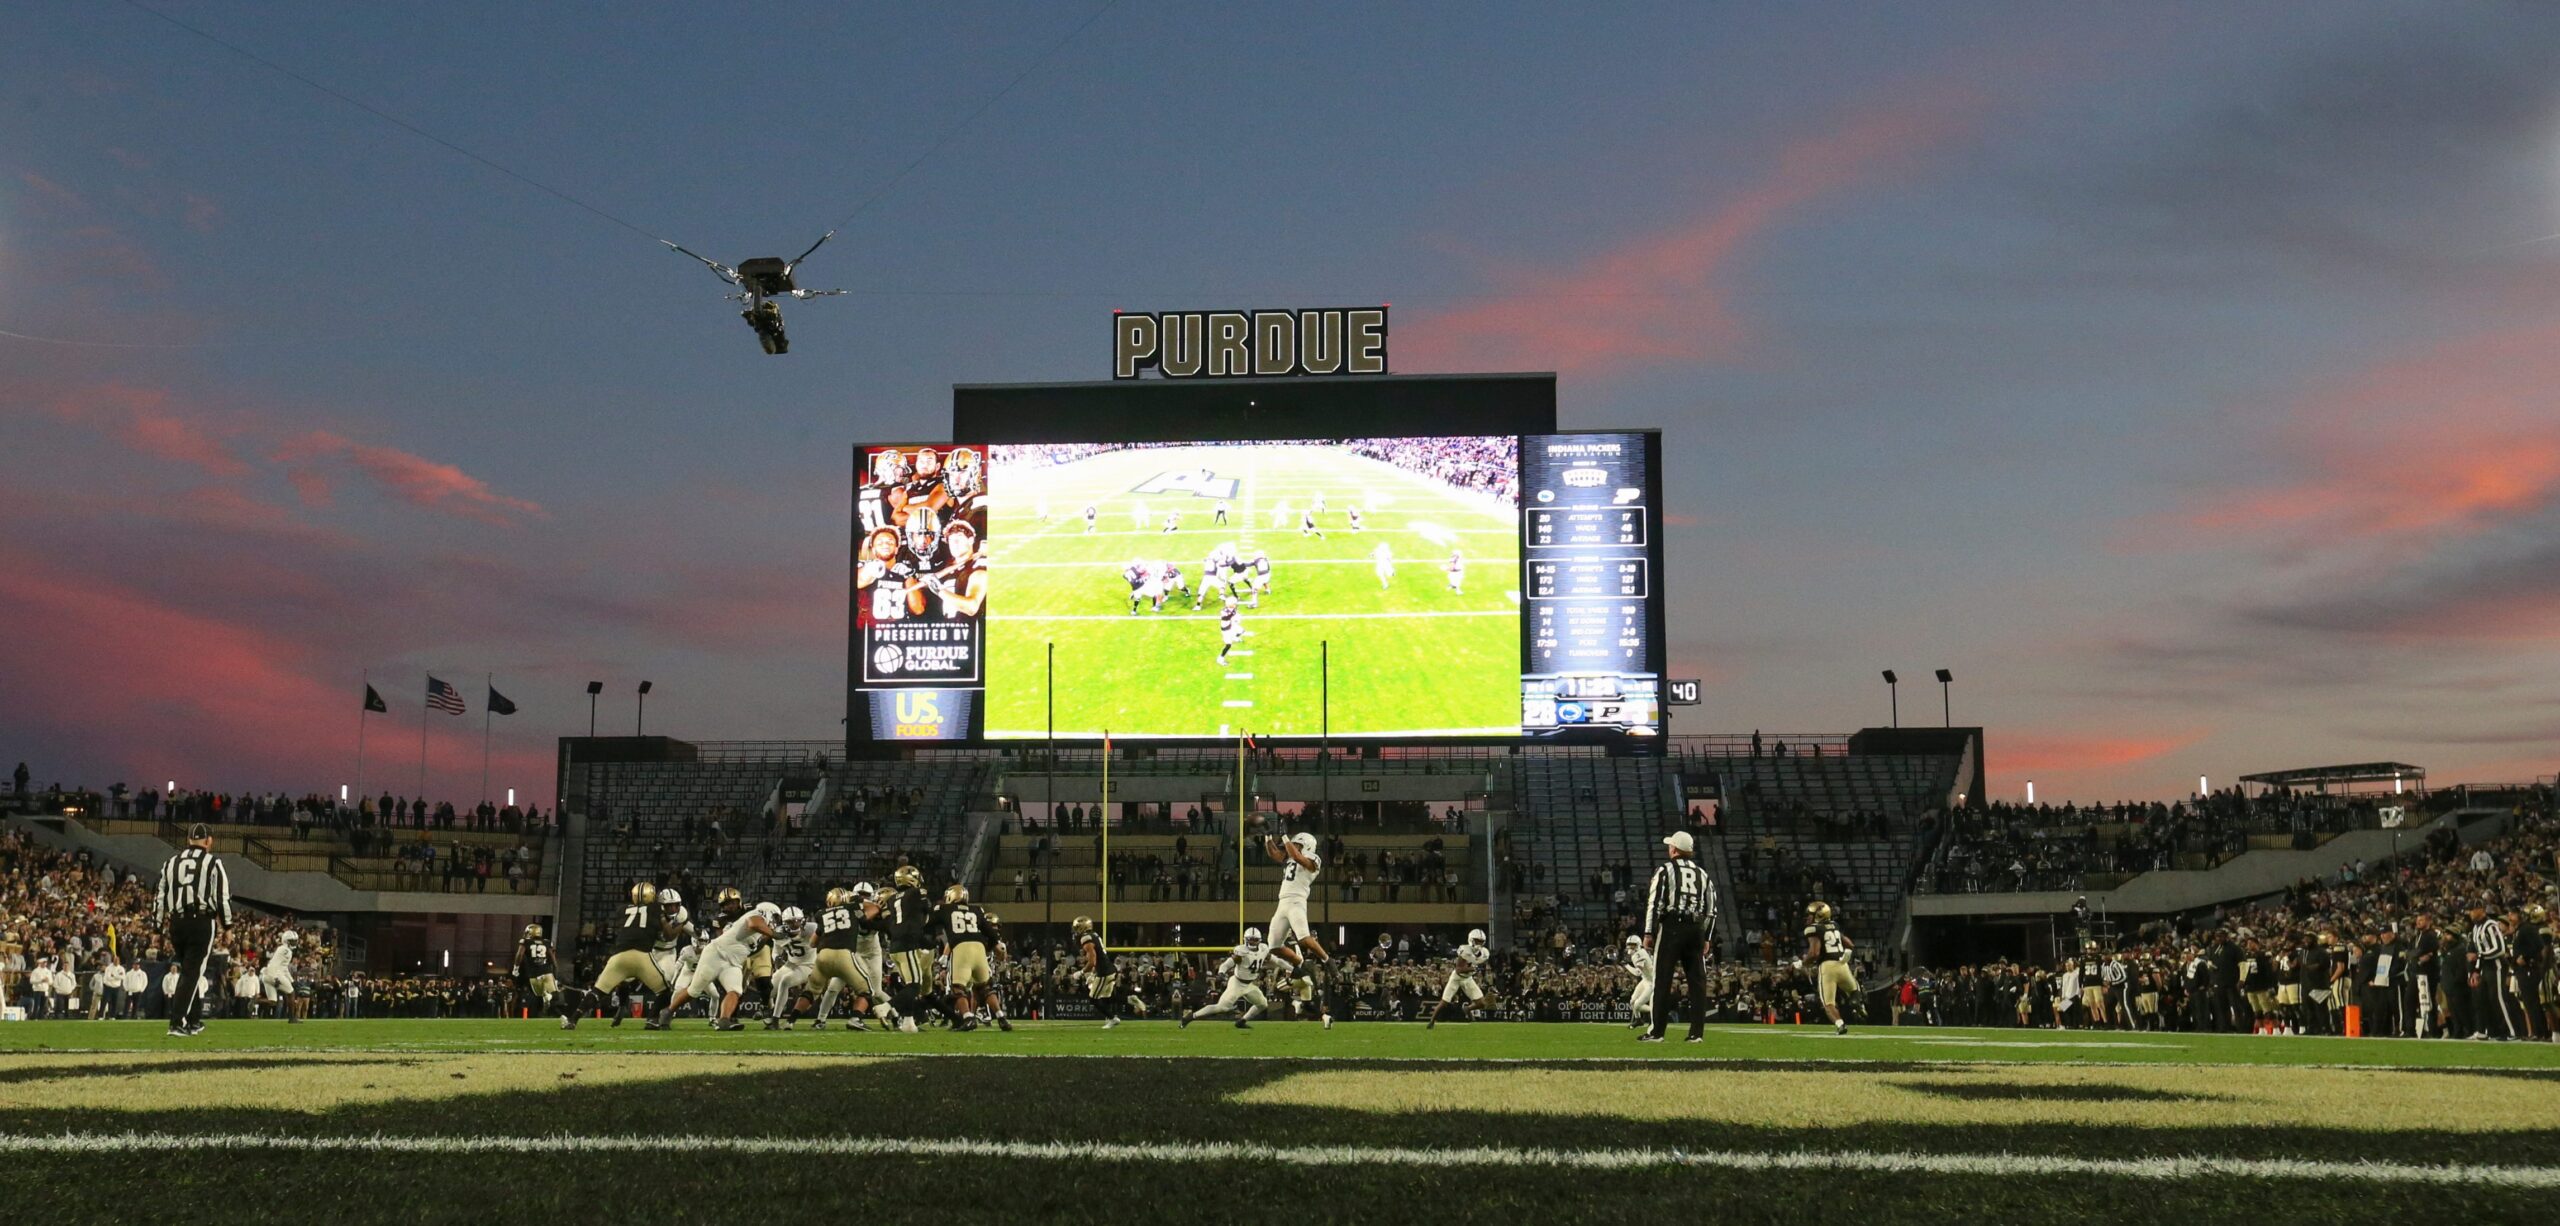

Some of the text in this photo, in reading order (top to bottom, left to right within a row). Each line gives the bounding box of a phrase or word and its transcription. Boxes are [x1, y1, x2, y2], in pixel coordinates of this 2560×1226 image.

[1117, 310, 1383, 377] PURDUE
[874, 628, 970, 642] PRESENTED BY
[905, 646, 969, 660] PURDUE
[1672, 682, 1697, 701] 40
[896, 723, 939, 737] FOODS
[178, 858, 197, 886] C
[1680, 867, 1698, 895] R
[624, 905, 648, 928] 71
[822, 909, 851, 934] 53
[894, 899, 903, 925] 1
[951, 910, 980, 934] 63
